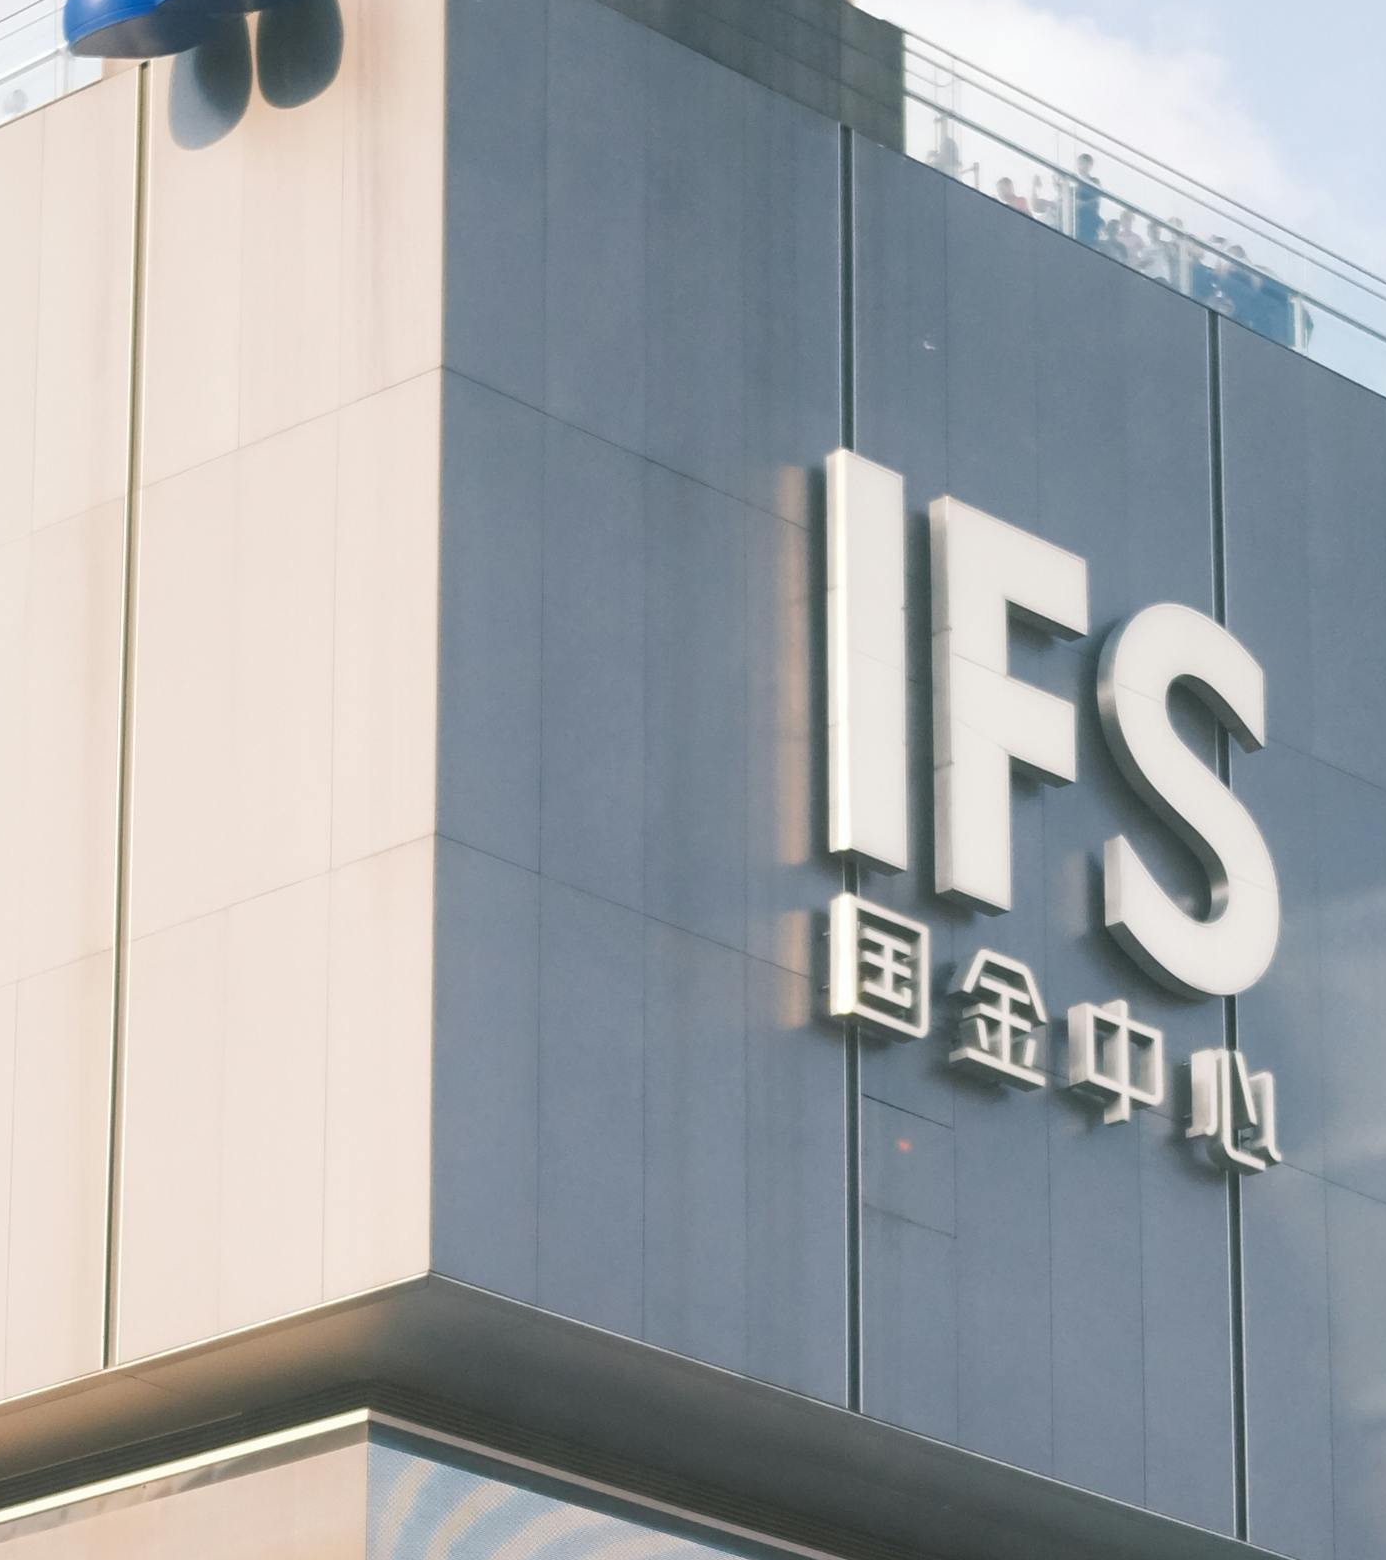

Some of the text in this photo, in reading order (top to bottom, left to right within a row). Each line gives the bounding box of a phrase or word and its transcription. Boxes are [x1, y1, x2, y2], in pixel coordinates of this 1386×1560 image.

[826, 446, 1281, 1000] IFS
[829, 892, 1282, 1176] 国金中心
